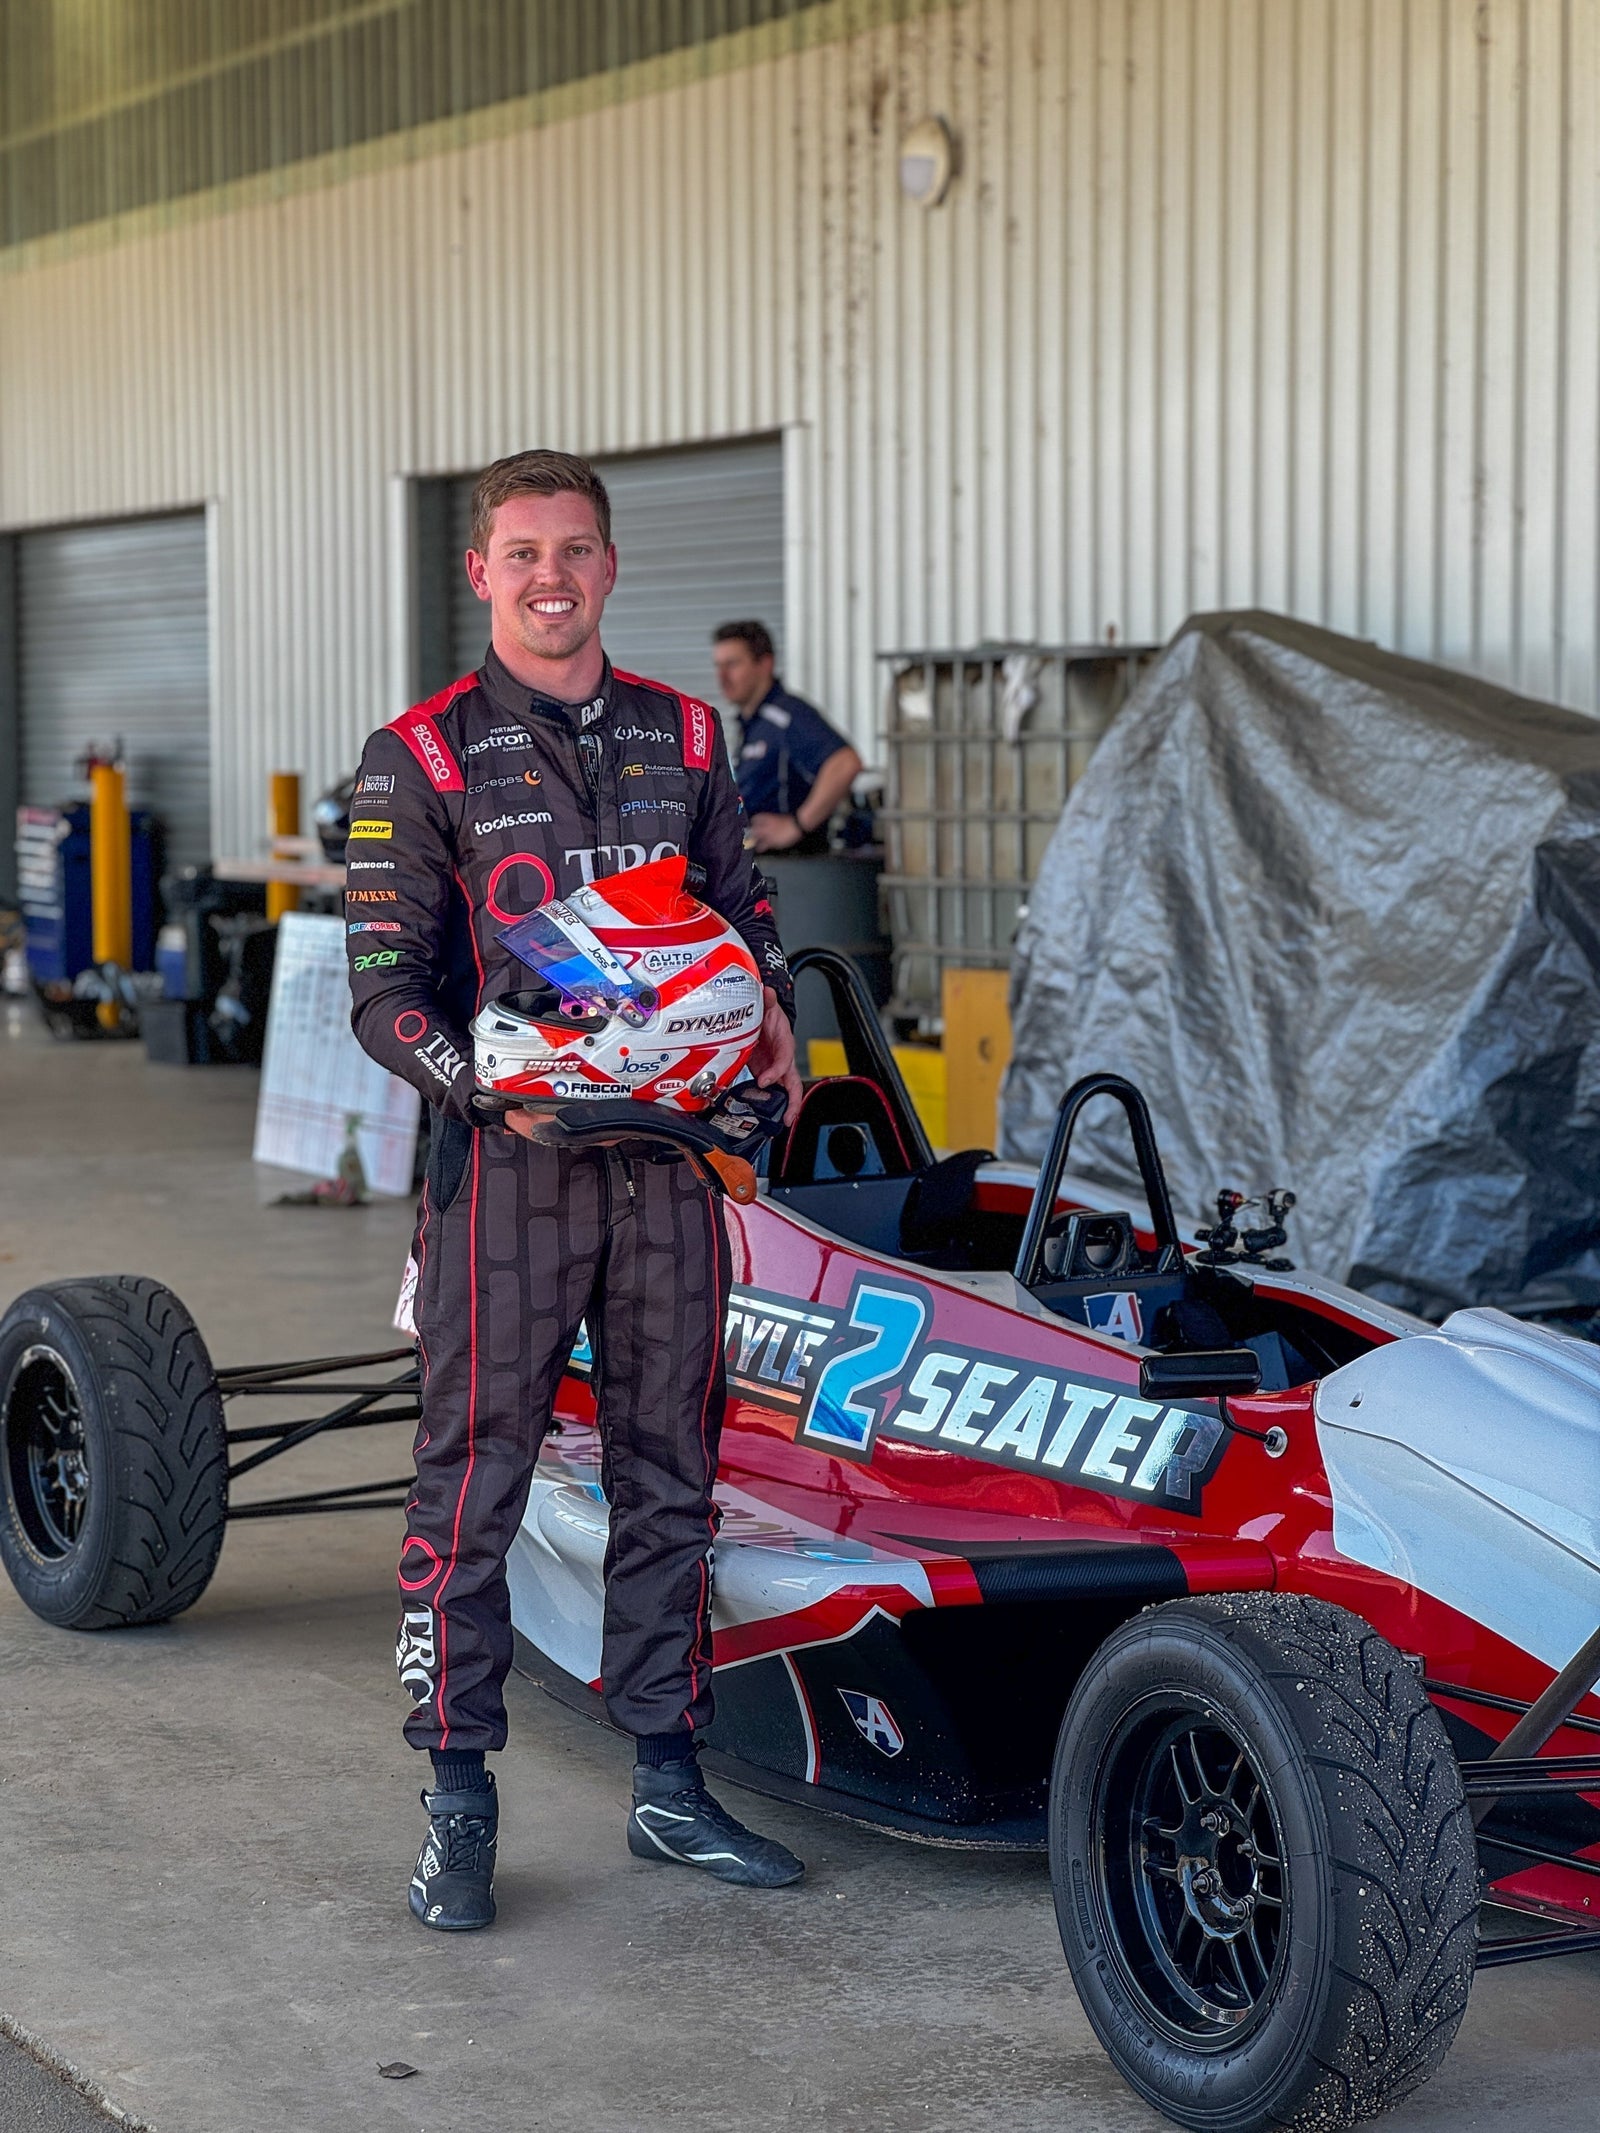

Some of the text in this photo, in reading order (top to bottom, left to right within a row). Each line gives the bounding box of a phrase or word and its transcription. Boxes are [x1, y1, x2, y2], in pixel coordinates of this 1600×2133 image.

[581, 698, 605, 727] BJR
[690, 703, 706, 759] sparco
[411, 724, 450, 782] sparco
[365, 782, 389, 791] BOOTS
[468, 775, 523, 795] coregas
[621, 800, 686, 812] DRILLPRO
[474, 810, 552, 836] tools.com
[346, 890, 398, 902] TIMKEN
[354, 950, 406, 972] acer
[650, 953, 692, 962] AUTO
[666, 1004, 754, 1033] DYNAMIC
[706, 1021, 743, 1035] Supplies
[571, 1083, 631, 1093] FABCON
[803, 1285, 925, 1450] 2
[894, 1353, 1224, 1499] SEATER
[401, 1603, 436, 1704] TRC
